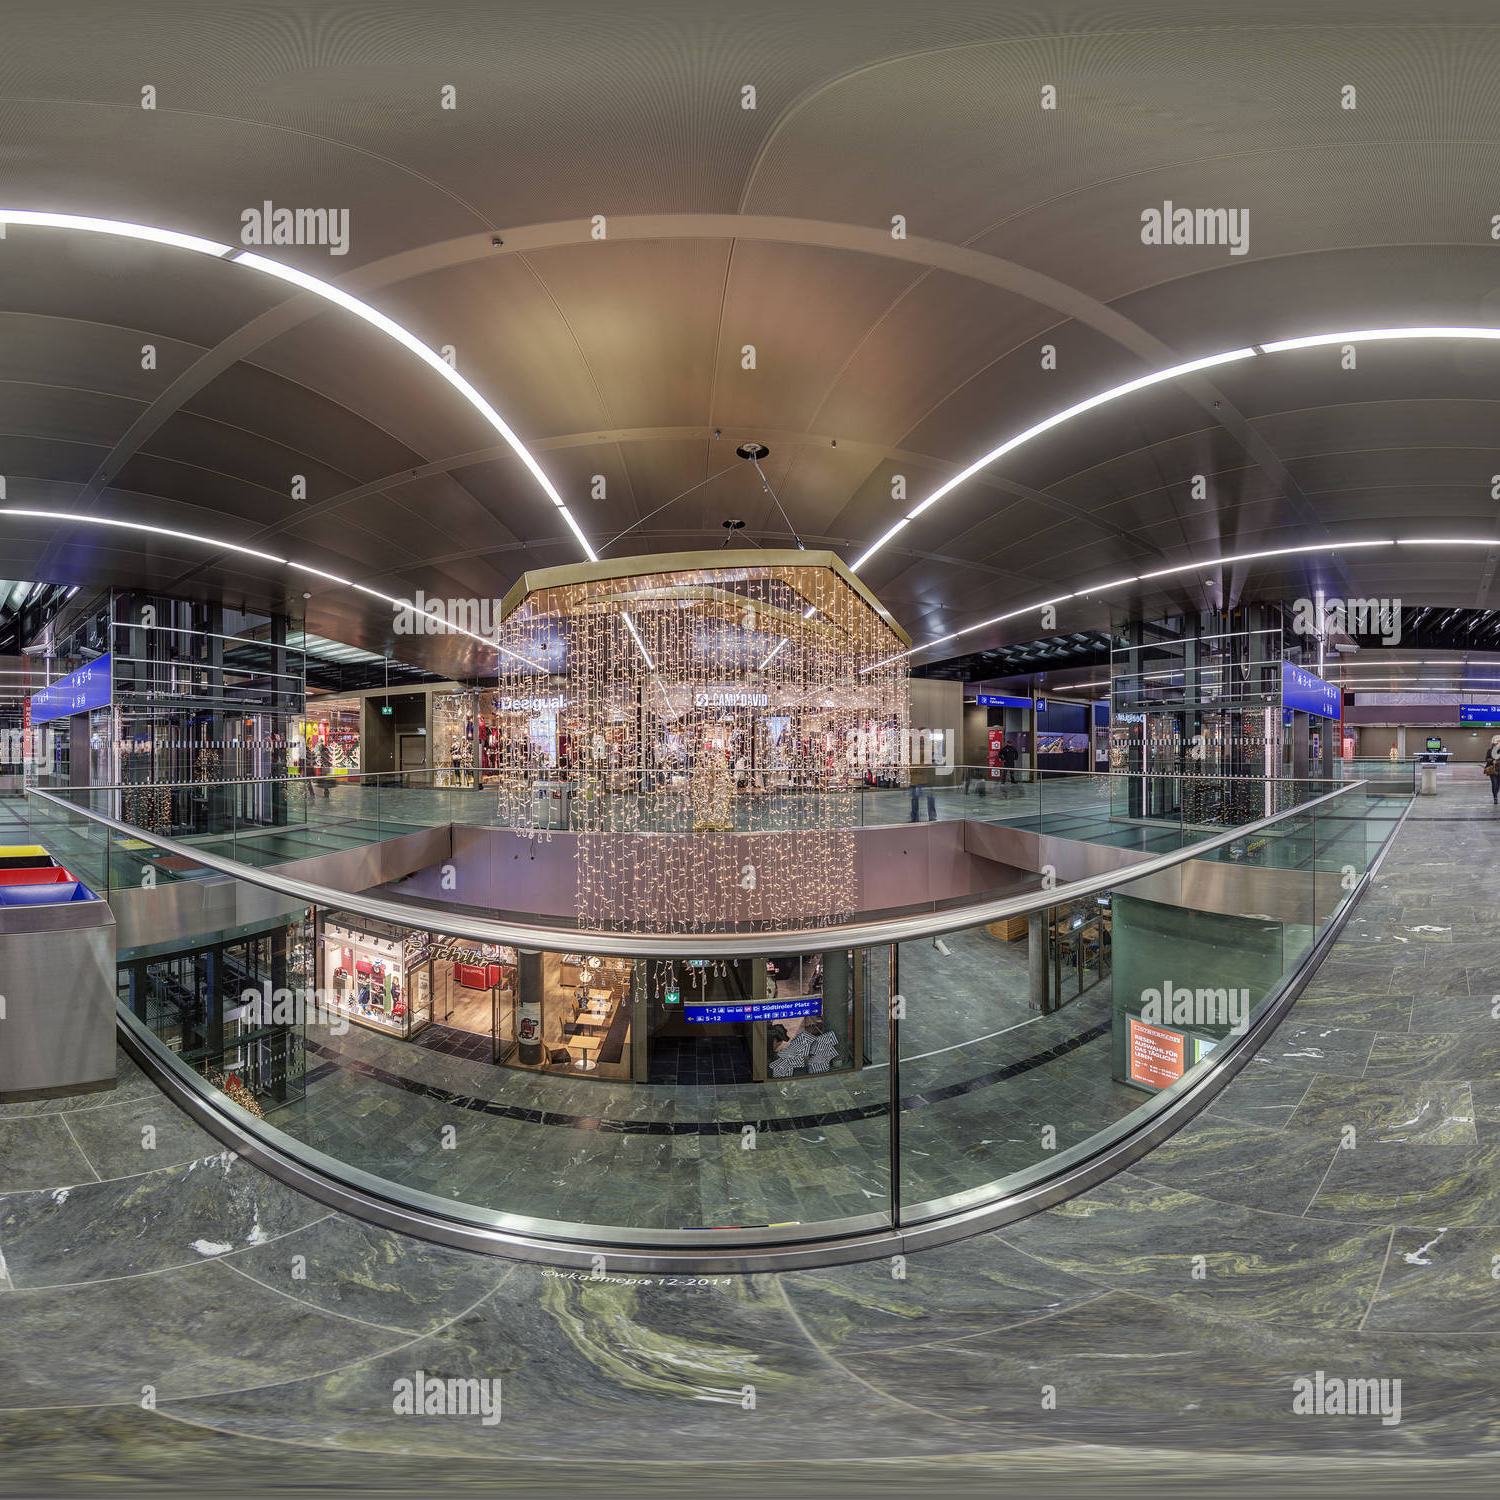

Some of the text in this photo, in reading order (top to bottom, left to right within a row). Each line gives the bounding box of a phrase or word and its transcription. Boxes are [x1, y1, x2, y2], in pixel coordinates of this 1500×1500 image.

[82, 668, 92, 684] 5-6
[1303, 675, 1311, 688] 3-4
[741, 694, 768, 706] DAVID
[762, 1002, 792, 1010] Südtiroler
[1134, 1034, 1156, 1046] RIESEN-
[1134, 1040, 1178, 1058] AUSWAHL FÜR
[1134, 1046, 1178, 1063] DAS TÄGLICHE
[1134, 1052, 1154, 1062] LEBEN.
